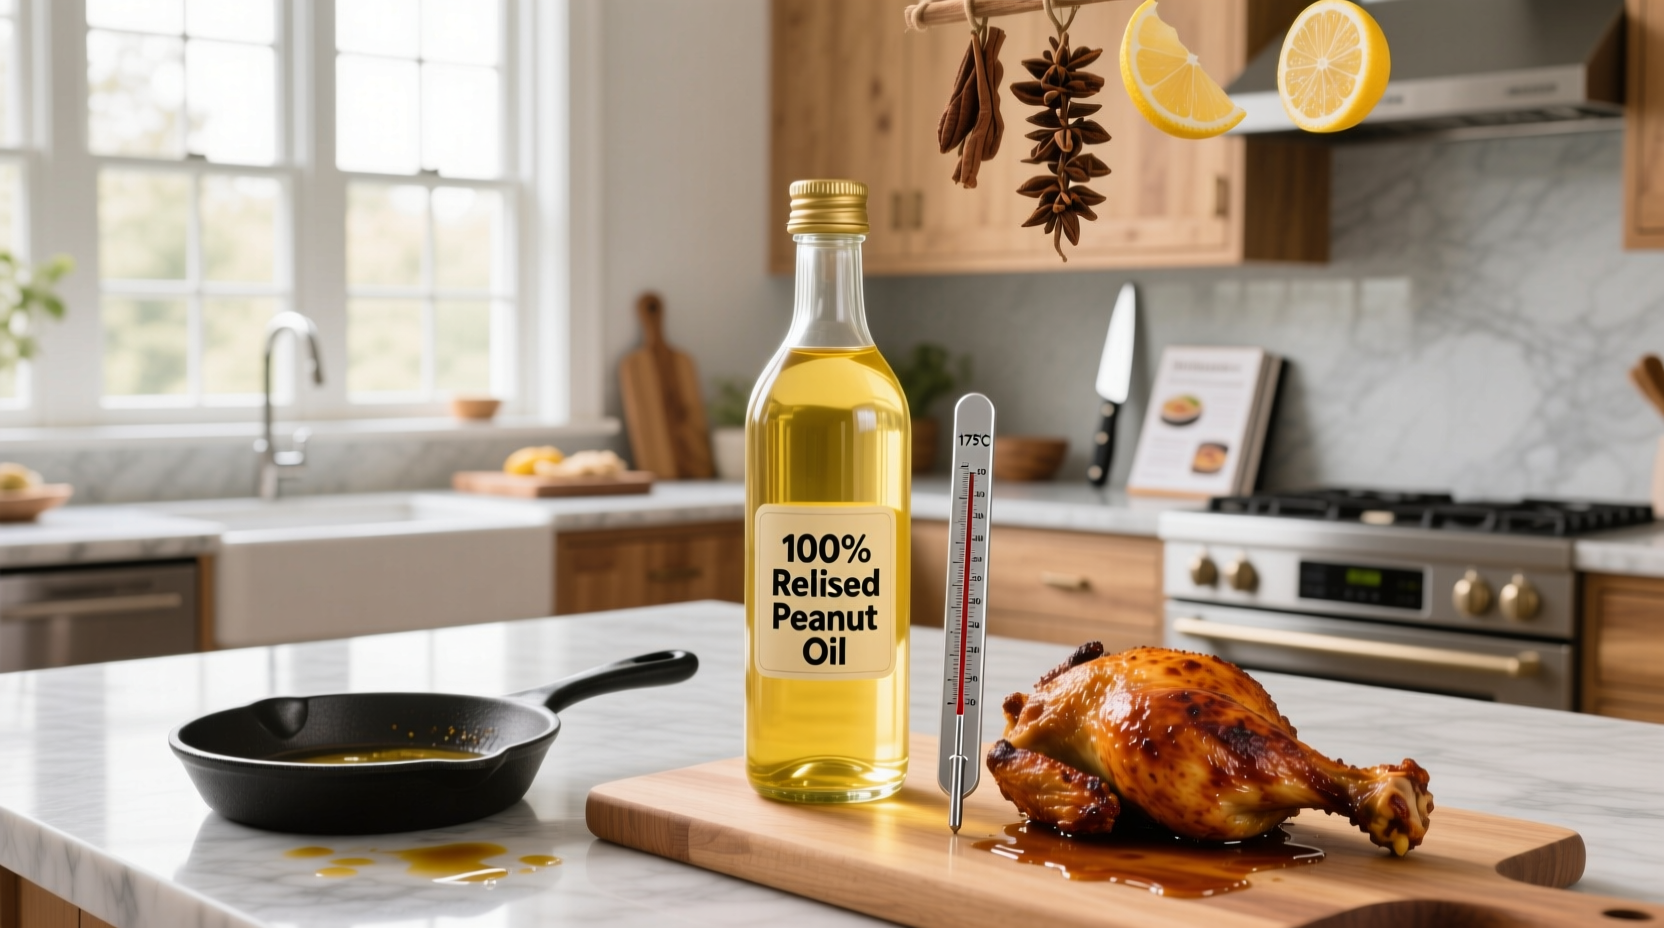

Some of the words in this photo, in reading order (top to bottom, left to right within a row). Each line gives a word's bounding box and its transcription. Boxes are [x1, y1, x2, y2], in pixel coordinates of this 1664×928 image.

[782, 533, 871, 563] 100%
[772, 568, 880, 597] Relised
[772, 602, 878, 631] Peanut
[802, 636, 846, 665] Oil
